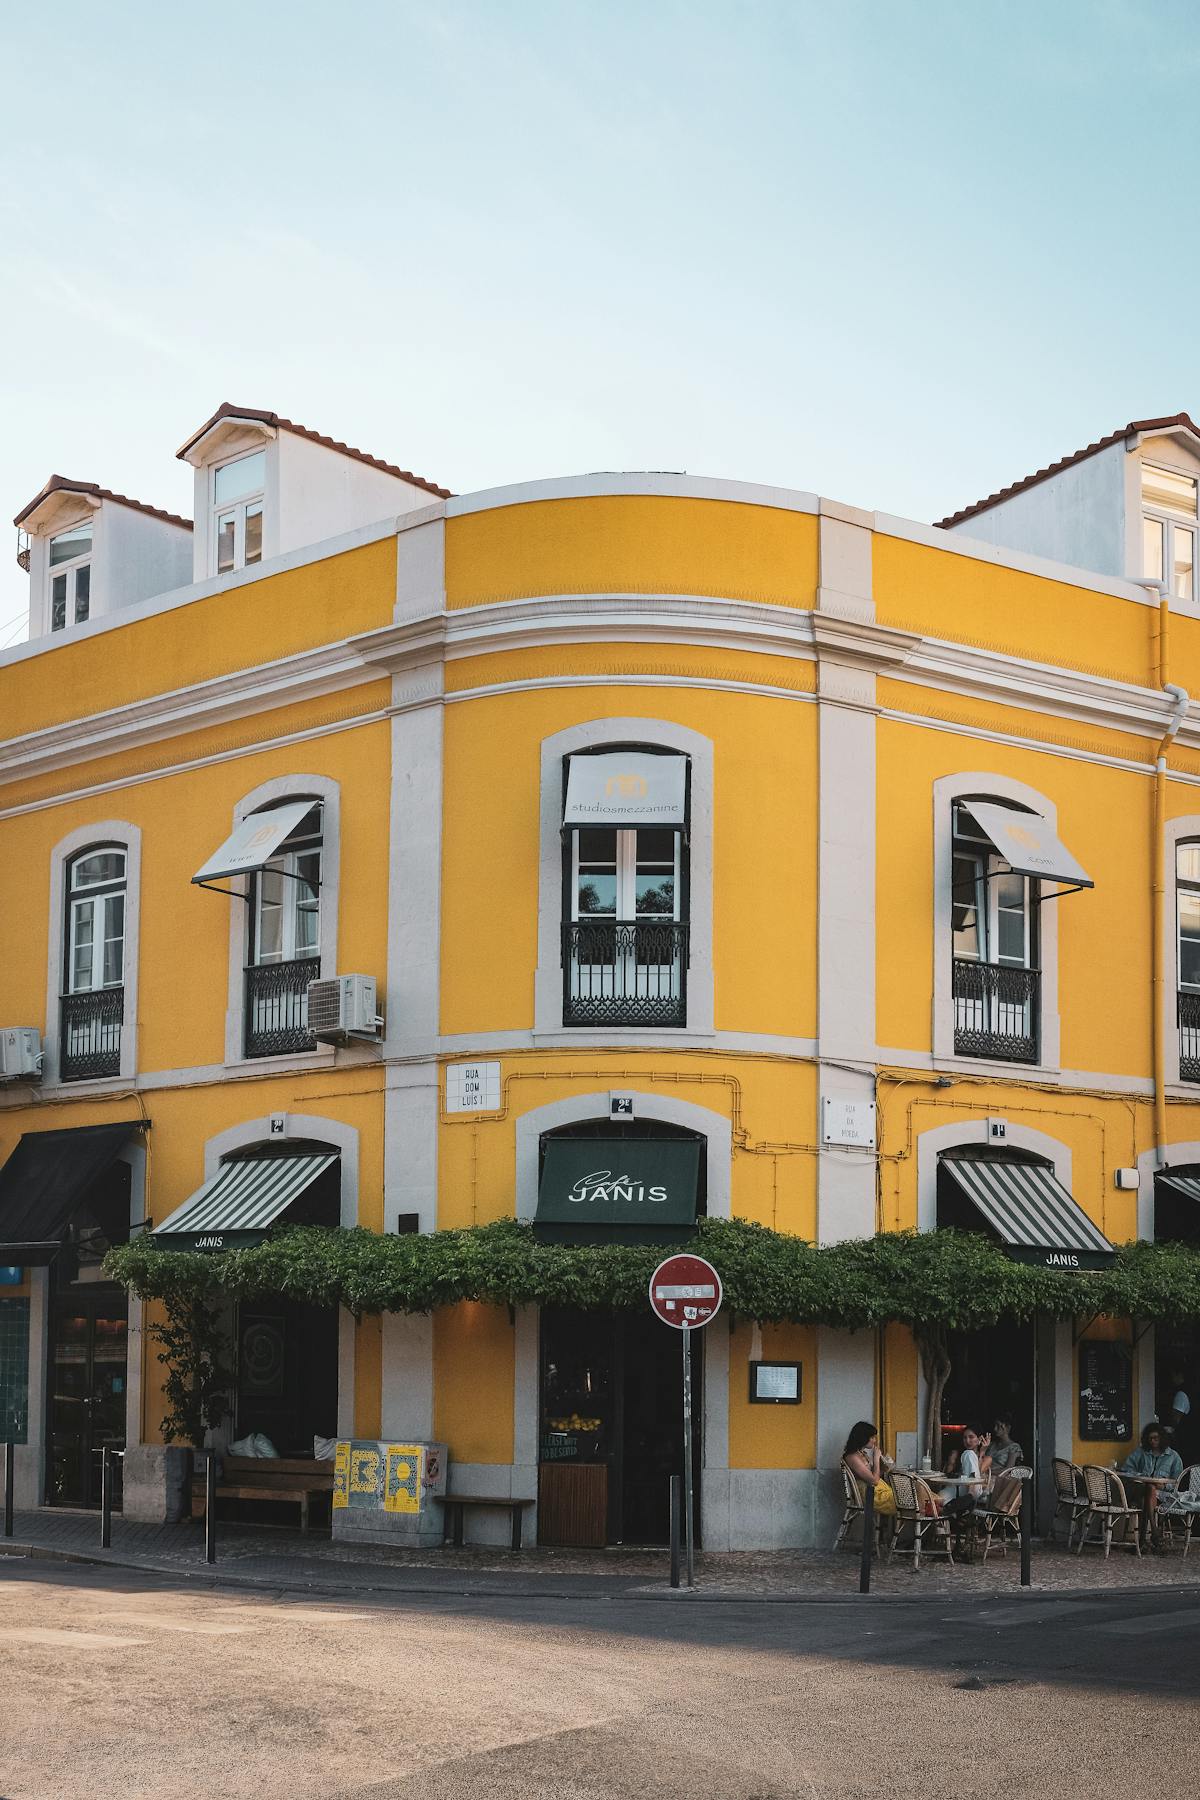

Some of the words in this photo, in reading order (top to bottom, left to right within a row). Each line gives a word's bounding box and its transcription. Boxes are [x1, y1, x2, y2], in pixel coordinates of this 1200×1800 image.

[572, 801, 679, 814] studiosmezzanine
[465, 1069, 479, 1080] RUA
[465, 1082, 480, 1093] DOM
[617, 1099, 630, 1112] 2E
[568, 1186, 668, 1202] JANIS
[195, 1236, 223, 1248] JANIS
[1046, 1253, 1079, 1267] JANIS
